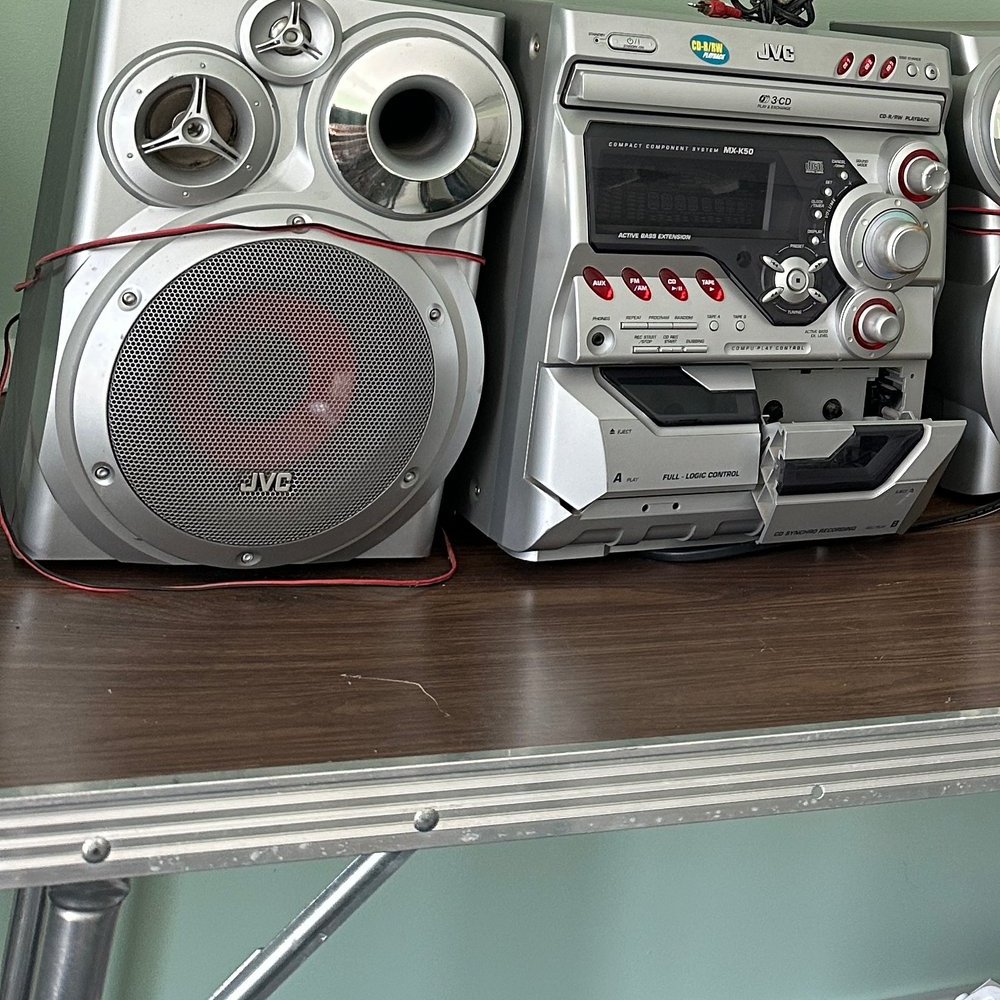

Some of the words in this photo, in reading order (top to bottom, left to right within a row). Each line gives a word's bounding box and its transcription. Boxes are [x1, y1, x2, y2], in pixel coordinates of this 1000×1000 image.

[691, 39, 723, 54] CD-R/RW
[757, 43, 795, 62] JVC
[608, 141, 643, 149] COMPACT
[646, 143, 689, 151] COMPONENT
[723, 146, 754, 156] MX-K50
[618, 232, 639, 240] ACTIVE
[240, 472, 292, 492] JVC
[613, 472, 622, 483] A
[662, 473, 680, 481] FULL
[685, 472, 706, 480] LOGIC
[708, 470, 740, 478] CONTROL
